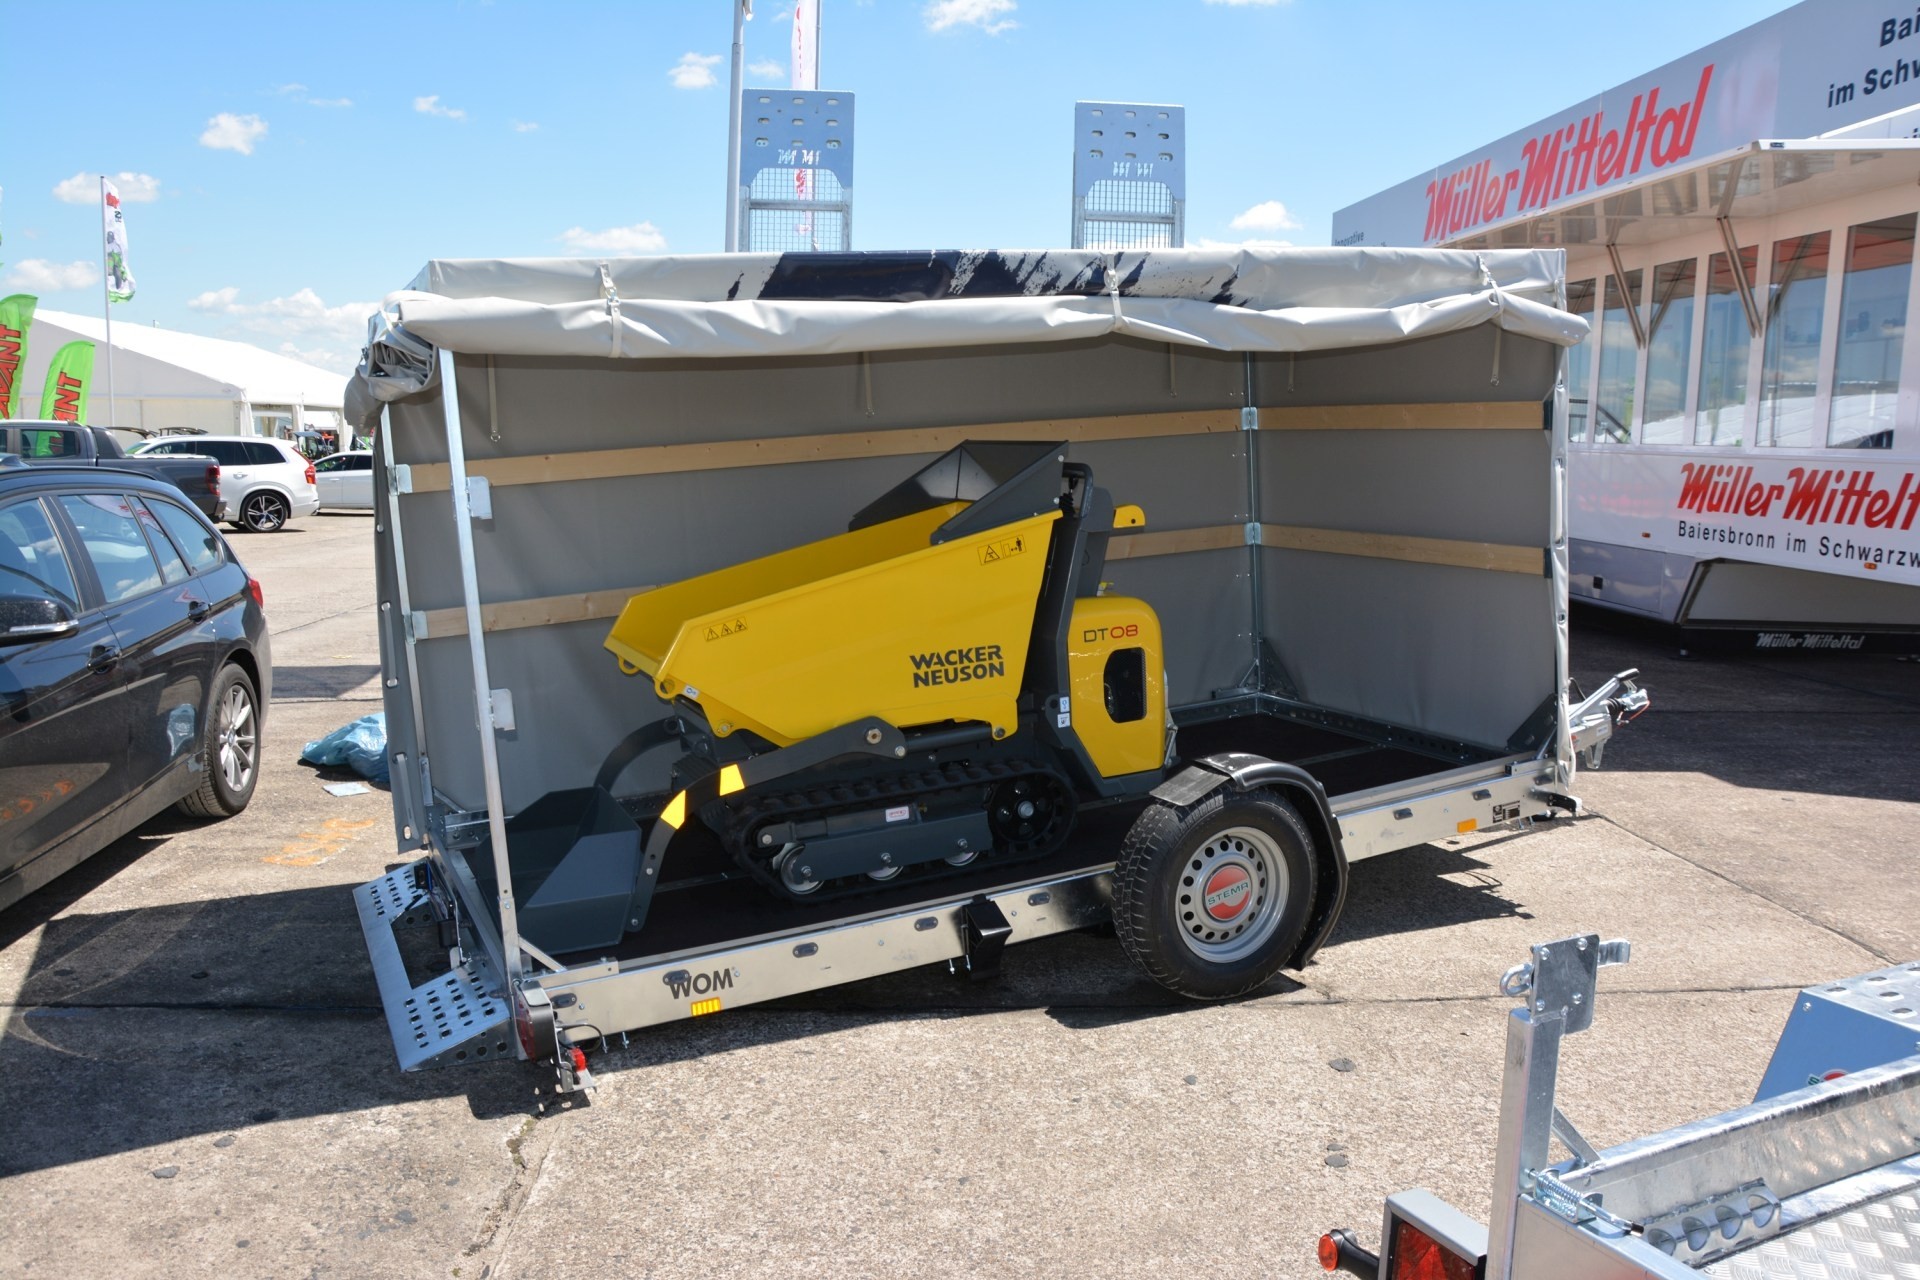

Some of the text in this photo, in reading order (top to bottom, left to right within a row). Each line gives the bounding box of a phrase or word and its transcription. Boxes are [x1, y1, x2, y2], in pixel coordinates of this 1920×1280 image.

[1827, 82, 1855, 109] im
[1423, 63, 1715, 243] Müller Mitteltal
[1677, 462, 1785, 518] Müller
[1678, 520, 1776, 549] Baiersbronn
[1786, 532, 1807, 553] im
[1756, 633, 1866, 650] Müller Mitteltal
[909, 644, 1003, 671] WACKER
[913, 661, 1005, 689] NEUSON
[1208, 882, 1249, 906] STEMA
[667, 967, 734, 1000] WOM
